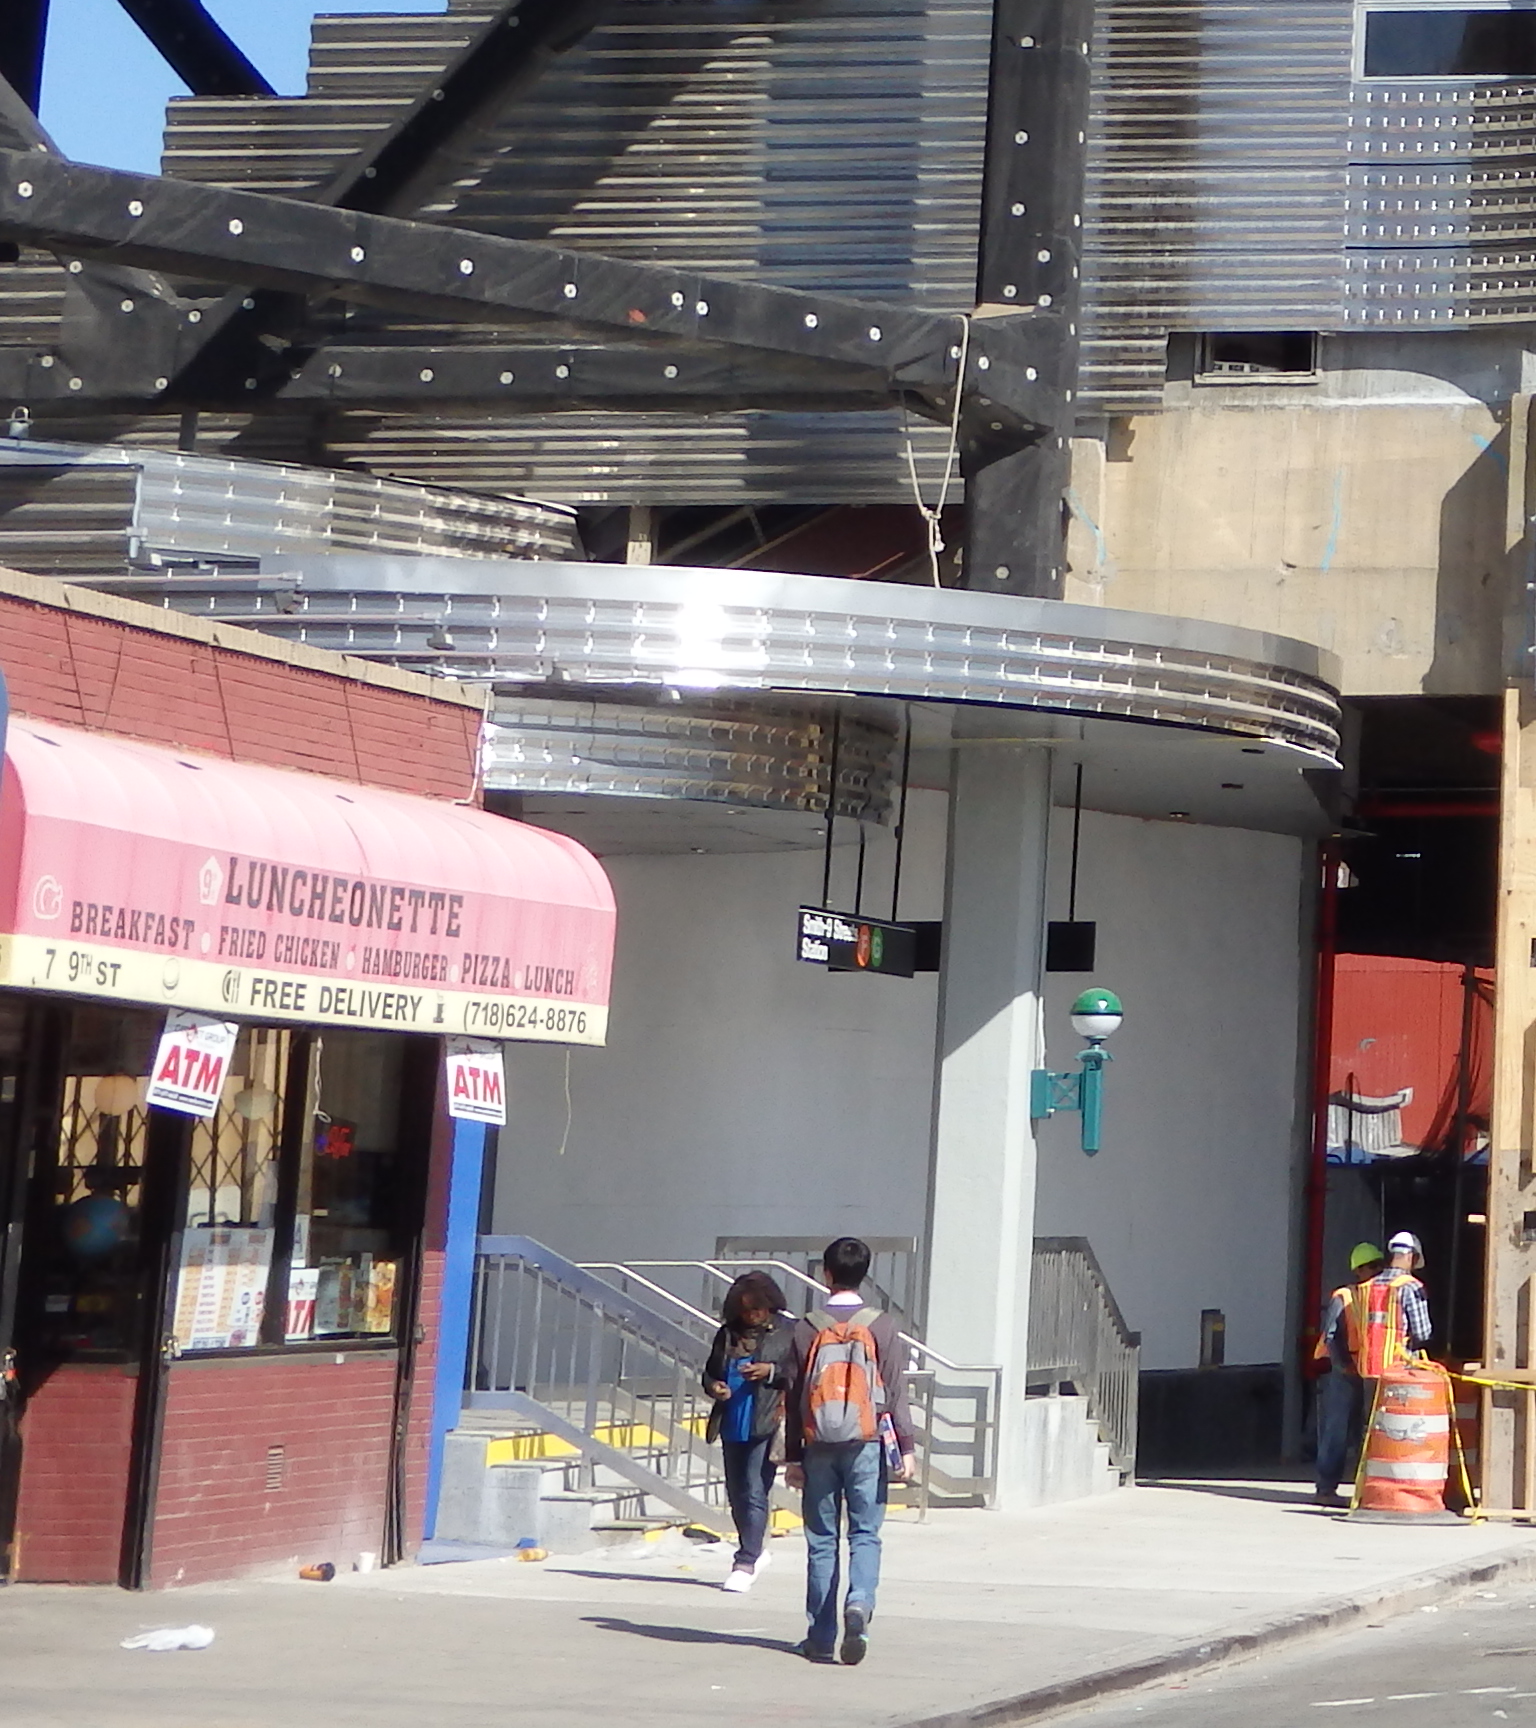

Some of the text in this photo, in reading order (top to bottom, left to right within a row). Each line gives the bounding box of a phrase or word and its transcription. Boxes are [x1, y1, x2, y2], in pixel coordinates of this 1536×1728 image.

[225, 856, 464, 938] LUNCHEONETTE
[46, 948, 57, 979] 7
[96, 961, 121, 987] ST
[70, 901, 574, 995] BREAKFAST FRIED CHICKEN HAMBURGER PIZZA LUNCH
[250, 978, 587, 1034] FREE DELIVERY (718)624-8876
[157, 1044, 223, 1096] ATM
[453, 1064, 502, 1105] ATM
